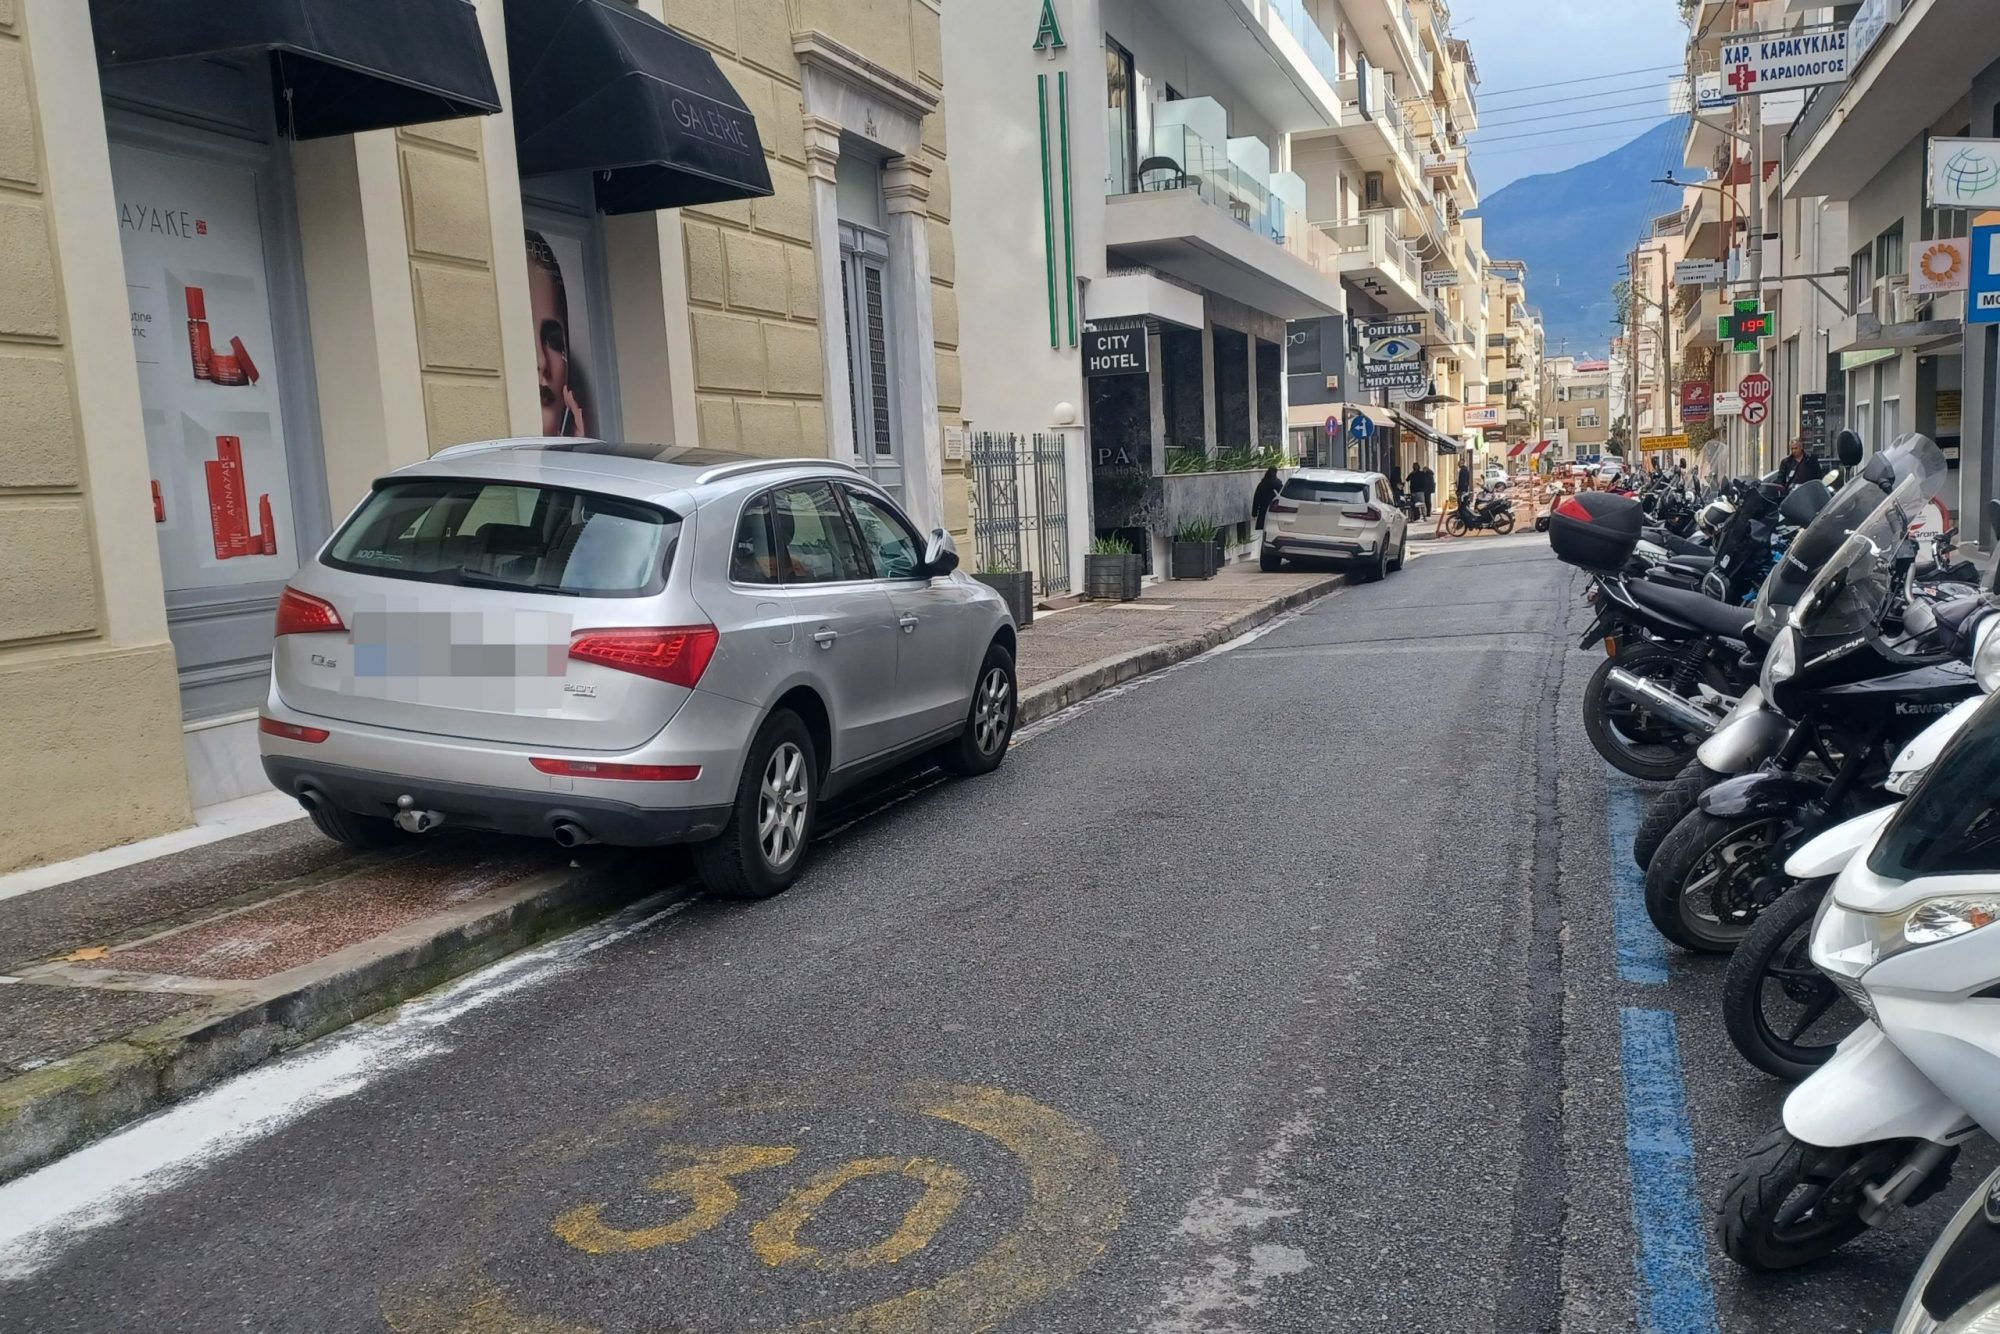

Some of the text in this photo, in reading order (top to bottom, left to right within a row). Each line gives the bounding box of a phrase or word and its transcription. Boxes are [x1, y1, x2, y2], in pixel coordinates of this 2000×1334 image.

[1032, 0, 1066, 50] A
[1725, 46, 1752, 64] ΧΑΡ.
[1761, 33, 1845, 60] ΚΑΡΑΚΥΚΛΑΣ
[1761, 59, 1844, 81] ΚΑΡΔΙΟΛΟΓΟΣ
[671, 98, 749, 149] GALERIE
[121, 203, 192, 239] AYAKE
[1368, 324, 1414, 335] ΟΠΤΙΚΑ
[1097, 335, 1130, 350] CITY
[1090, 353, 1139, 370] HOTEL
[1366, 375, 1419, 387] ΜΠΟΥΝΑΣ
[1741, 381, 1769, 398] STOP
[1895, 701, 1961, 715] Kawas
[551, 1144, 968, 1269] 30
